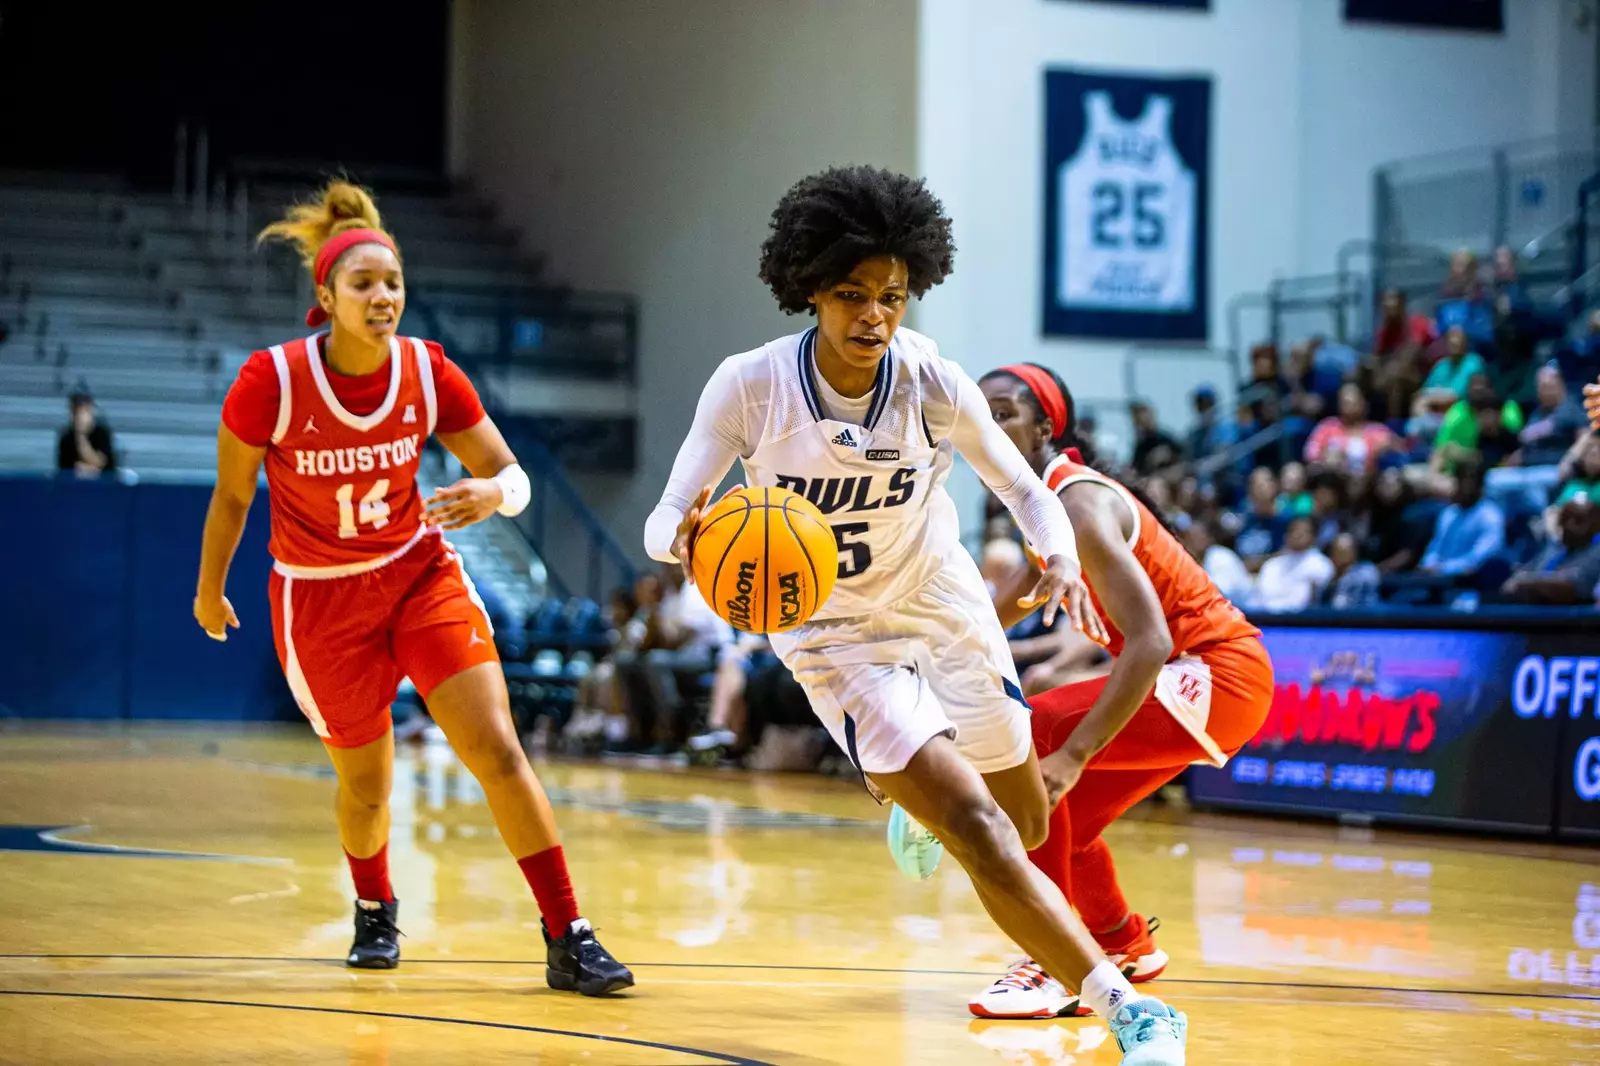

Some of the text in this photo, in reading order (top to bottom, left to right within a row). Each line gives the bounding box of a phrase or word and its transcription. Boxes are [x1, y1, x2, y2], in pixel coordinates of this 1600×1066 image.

[1092, 182, 1166, 249] 25
[295, 434, 420, 476] HOUSTON
[831, 438, 858, 448] adidas
[336, 479, 391, 539] 14
[830, 521, 872, 579] 5
[726, 561, 756, 631] Wilson
[777, 571, 799, 628] NCAA
